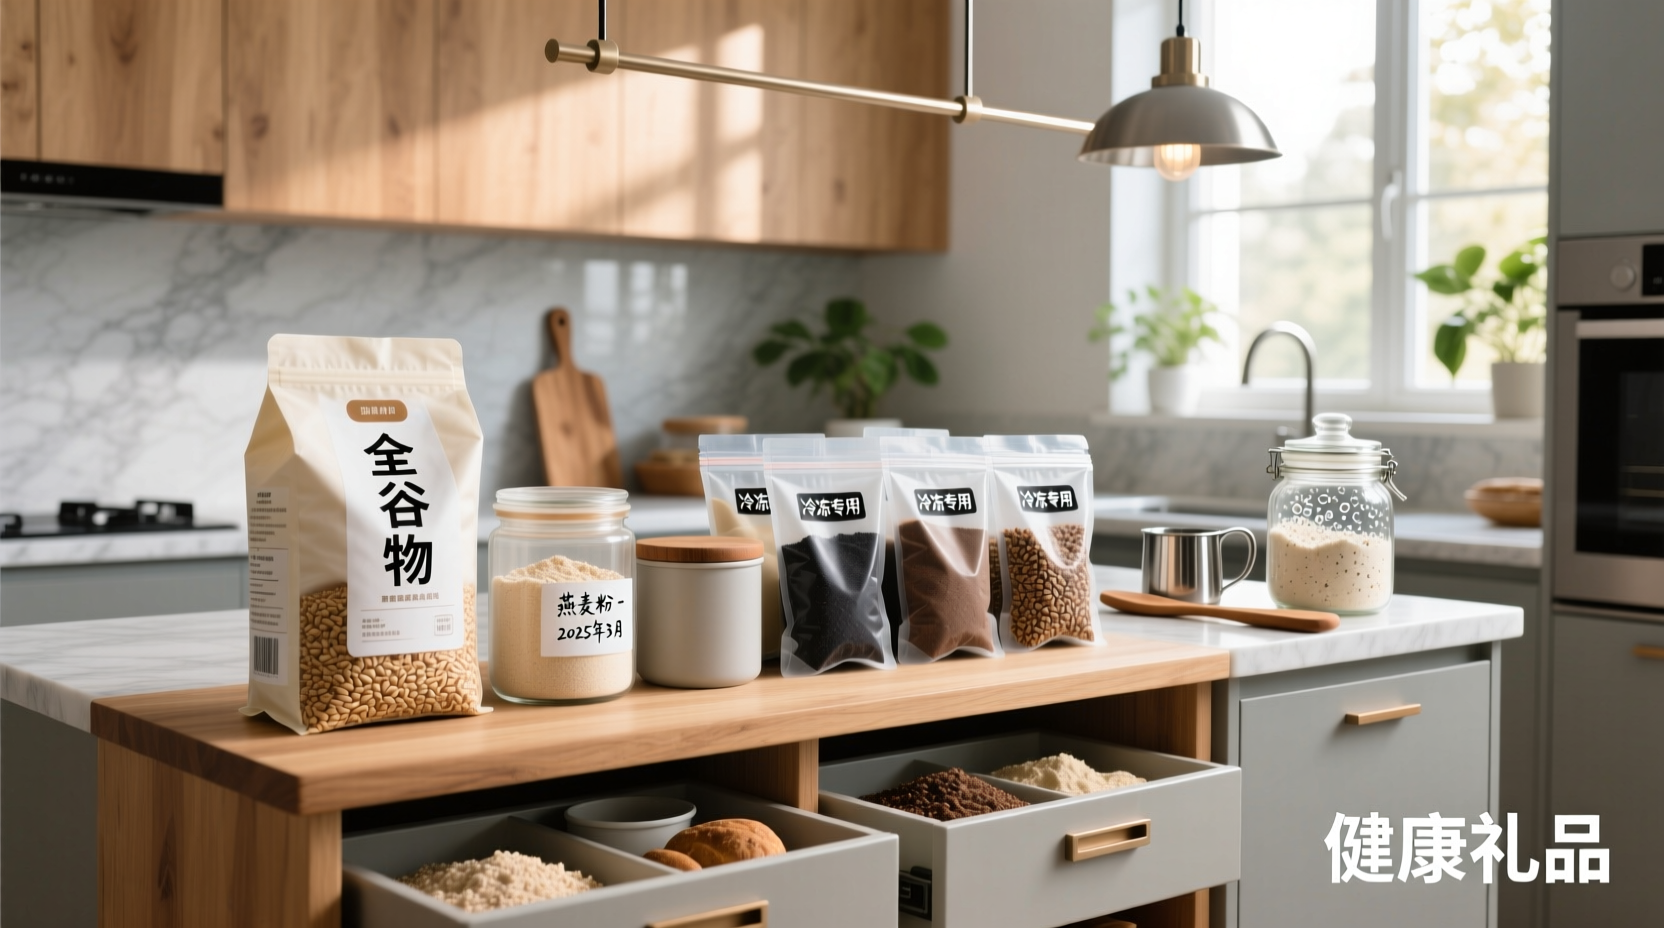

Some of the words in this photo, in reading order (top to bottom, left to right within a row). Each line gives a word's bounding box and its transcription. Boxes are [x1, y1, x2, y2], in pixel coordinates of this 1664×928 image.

[364, 432, 433, 587] 全谷物
[802, 497, 860, 517] 冷冻专用
[918, 493, 972, 512] 冷冻专用
[1020, 490, 1073, 510] 冷冻专用
[557, 620, 623, 643] 2025年3月
